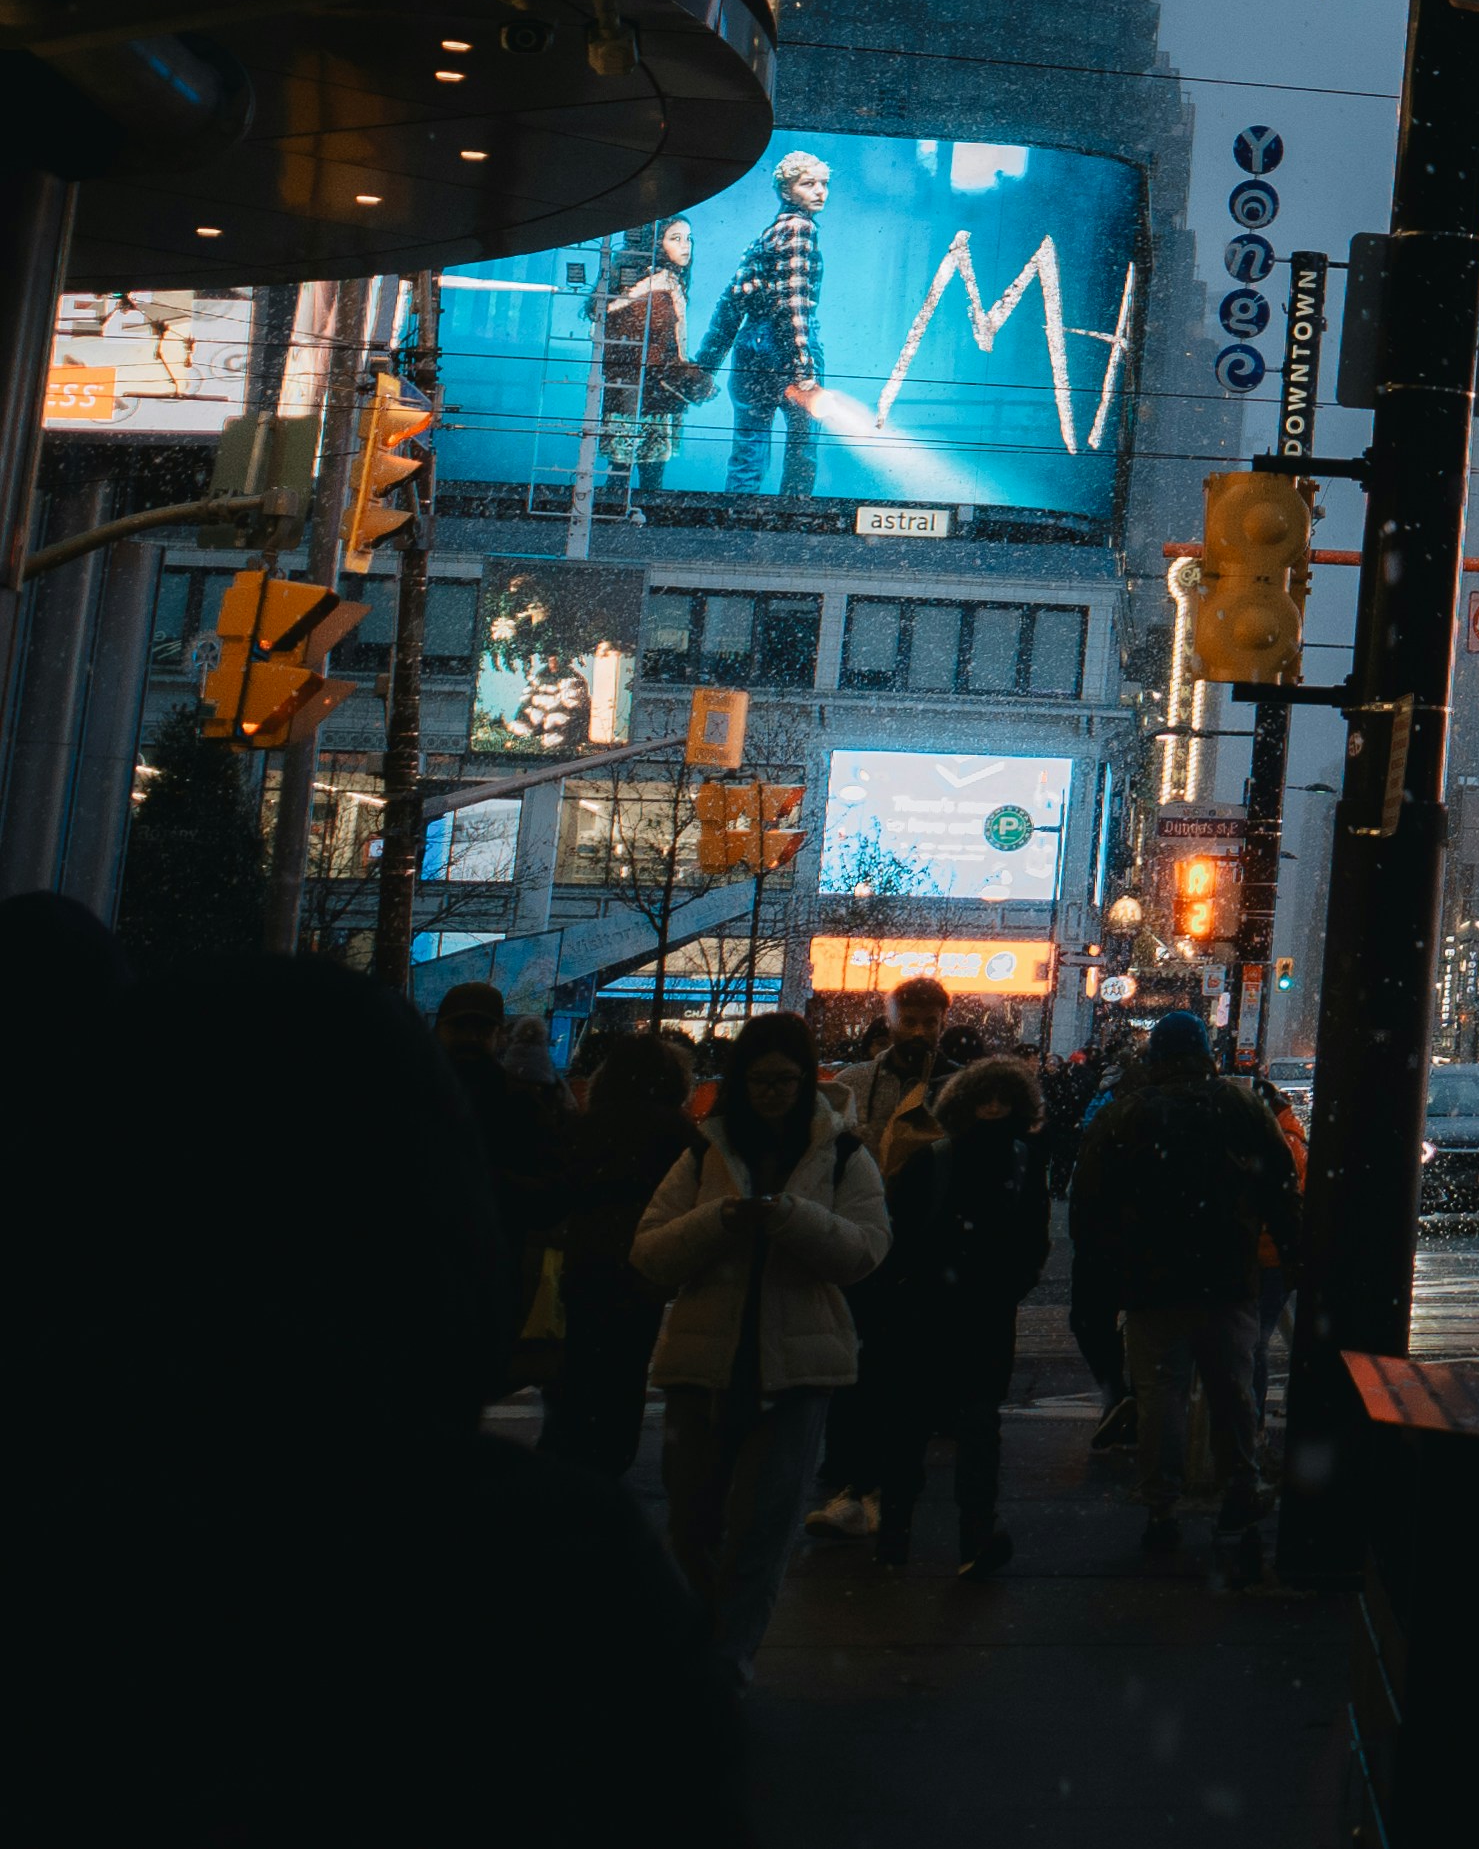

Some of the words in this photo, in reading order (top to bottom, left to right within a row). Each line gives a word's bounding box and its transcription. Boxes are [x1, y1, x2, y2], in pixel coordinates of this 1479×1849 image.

[1285, 270, 1318, 457] DOWNTOWN
[871, 512, 936, 532] astral
[1164, 820, 1213, 835] Dundas
